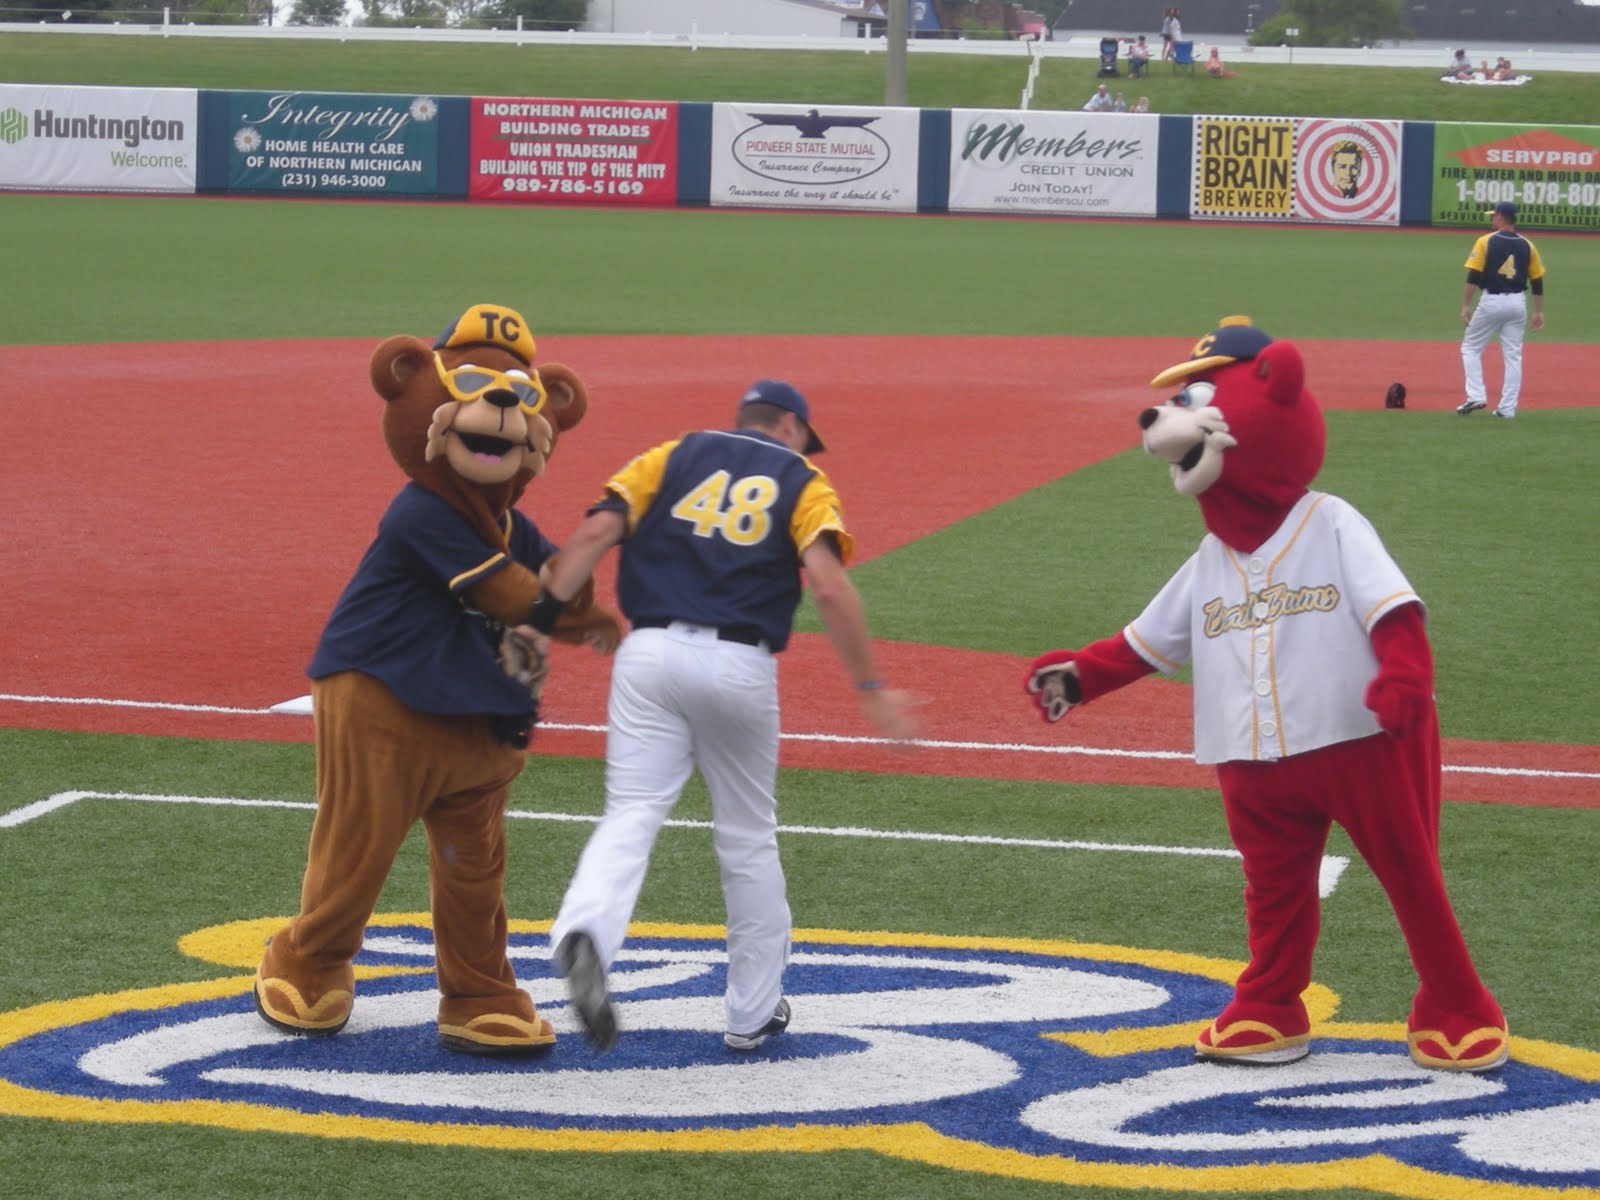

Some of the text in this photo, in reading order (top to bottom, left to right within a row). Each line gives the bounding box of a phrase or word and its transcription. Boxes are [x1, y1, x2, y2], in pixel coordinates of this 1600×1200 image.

[241, 91, 411, 141] Integrity
[483, 103, 667, 120] NORTHERN MICHIGAN
[34, 109, 184, 148] Huntington
[500, 122, 650, 137] BUILDING TRADES
[265, 140, 405, 155] HOME HEALTH CARE
[746, 141, 875, 155] PIONEER STATE MUTUAL
[961, 123, 1142, 162] Members
[1205, 124, 1290, 157] RIGHT
[510, 142, 637, 159] UNION TRADESMAN
[1486, 149, 1593, 166] SERVPRO
[110, 151, 188, 168] Welcome.
[246, 156, 422, 172] OF NORTHERN MICHIGAN
[758, 160, 862, 174] Insurance Company
[480, 160, 666, 179] BUILDING THE TIP OF THE MITT
[1020, 164, 1134, 177] CREDIT UNION
[1204, 157, 1288, 189] BRAIN
[1473, 168, 1515, 180] WATER
[1519, 169, 1543, 181] AND
[1547, 170, 1581, 182] MOLD
[282, 173, 386, 187] (231) 946-3000
[503, 178, 643, 195] 989-786-5169
[728, 185, 780, 197] Insurance
[784, 188, 800, 198] the
[804, 191, 825, 200] way
[829, 190, 839, 199] it
[842, 190, 876, 200] should
[993, 194, 1109, 207] www.memberscu.com
[1203, 189, 1287, 208] BREWERY
[1498, 254, 1517, 279] 4
[480, 312, 520, 342] TC
[1193, 334, 1217, 356] C
[670, 469, 780, 546] 48
